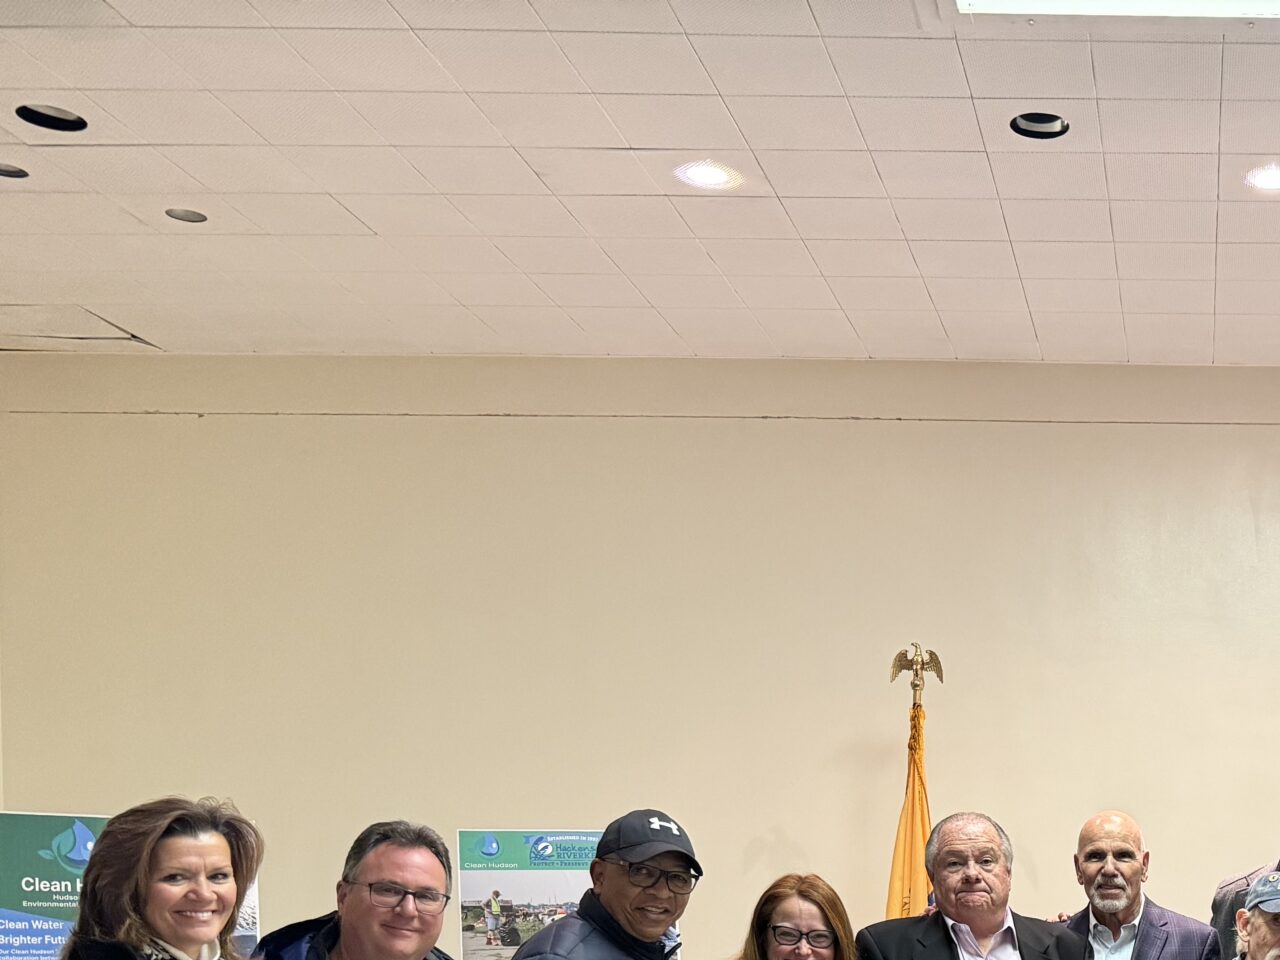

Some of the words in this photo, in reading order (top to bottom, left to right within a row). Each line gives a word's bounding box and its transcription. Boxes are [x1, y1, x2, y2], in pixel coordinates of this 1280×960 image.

[21, 876, 72, 892] Clean
[0, 920, 29, 929] Clean
[31, 920, 64, 930] Water
[0, 935, 42, 947] Brighter
